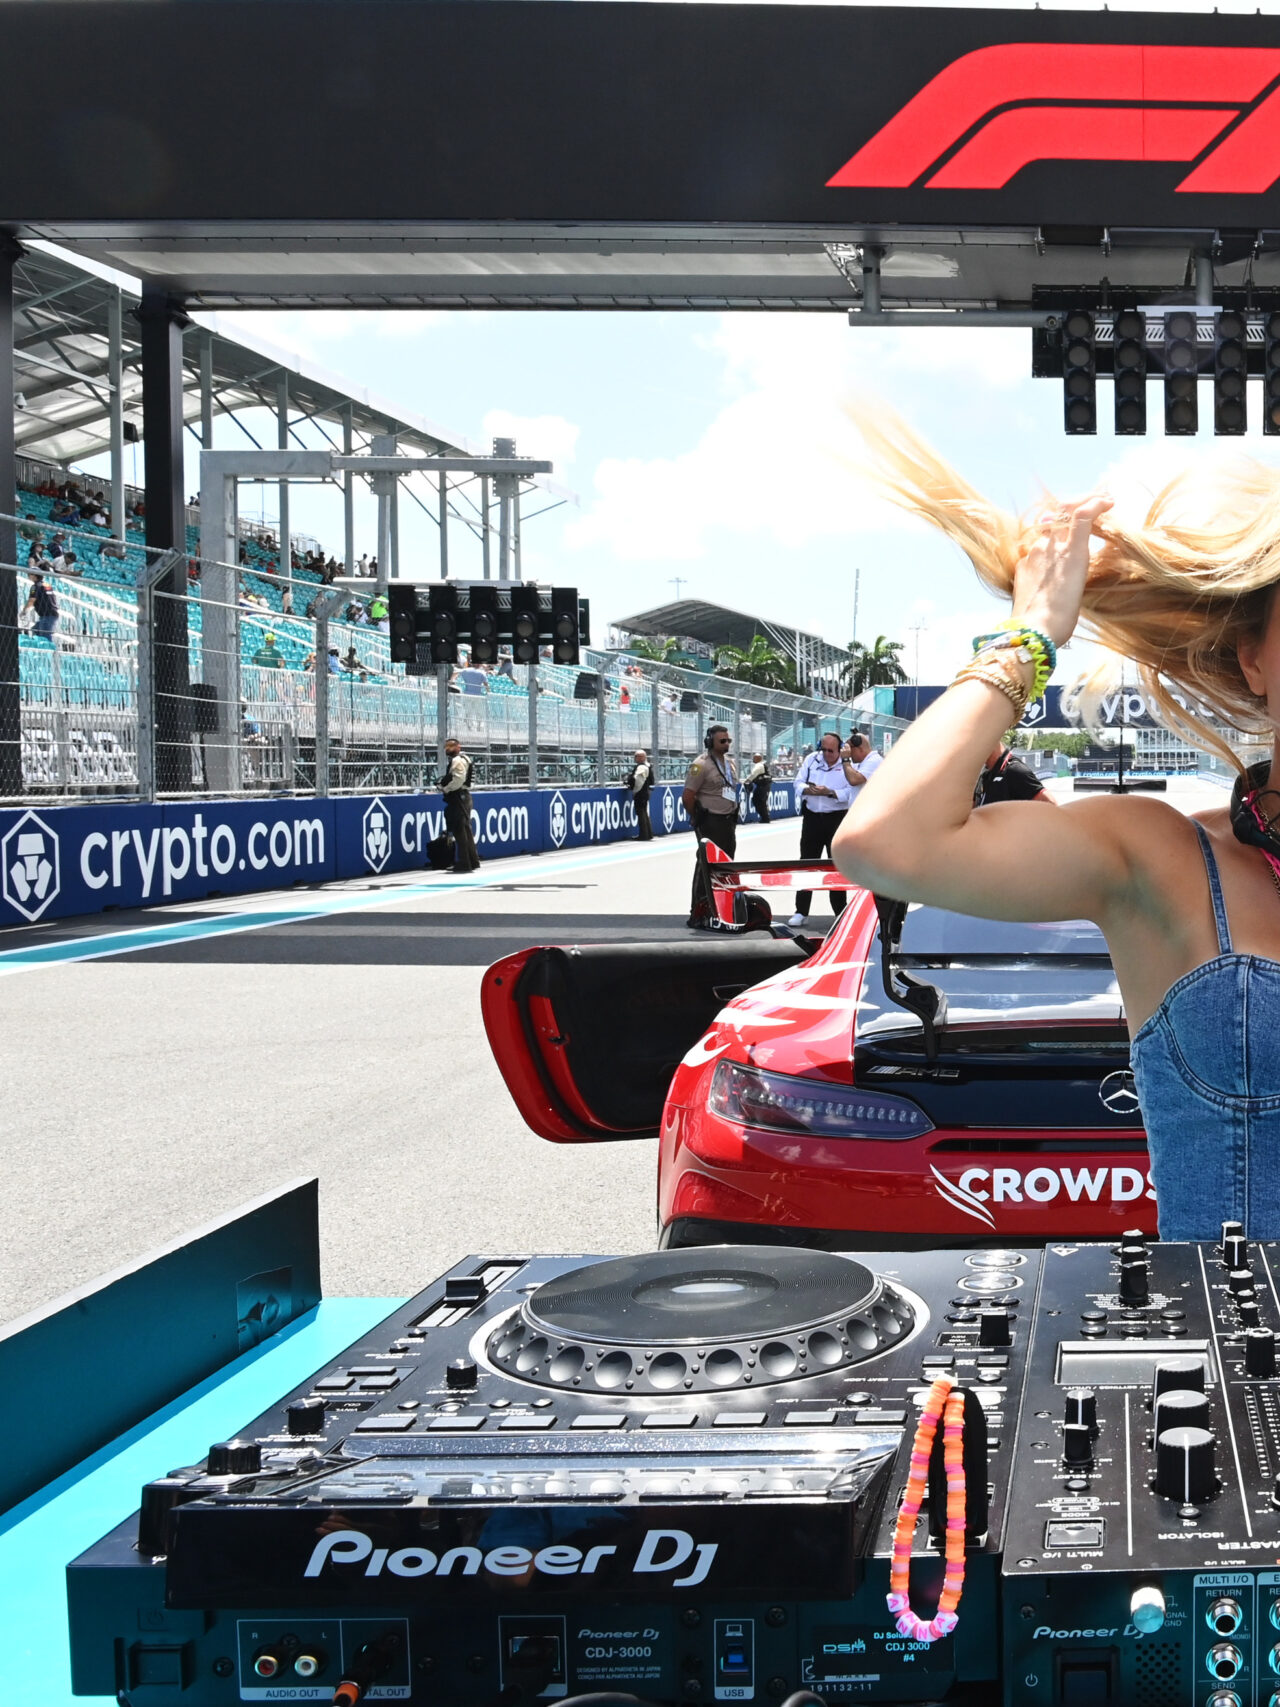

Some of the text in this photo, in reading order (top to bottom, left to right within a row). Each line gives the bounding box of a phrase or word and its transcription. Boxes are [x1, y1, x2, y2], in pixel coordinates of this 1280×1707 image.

[571, 794, 638, 841] crypto.co
[401, 806, 528, 853] cryo.com
[80, 813, 325, 897] crypto.com
[896, 1066, 960, 1078] AMG
[304, 1530, 617, 1577] Pioneer
[1067, 1550, 1104, 1558] MULTI
[1199, 1575, 1249, 1584] MULTI I/O
[1206, 1589, 1242, 1597] RETURN
[1164, 1620, 1182, 1628] GND
[577, 1628, 639, 1639] Pioneer
[873, 1632, 884, 1640] DJ
[1033, 1626, 1118, 1639] Pioneer
[885, 1642, 930, 1651] CDJ 3000
[585, 1646, 652, 1658] CDJ-3000
[903, 1653, 915, 1662] #4
[1211, 1681, 1236, 1690] SEND
[265, 1689, 319, 1698] AUDIO OUT
[391, 1688, 406, 1697] OUT
[724, 1688, 745, 1698] USB
